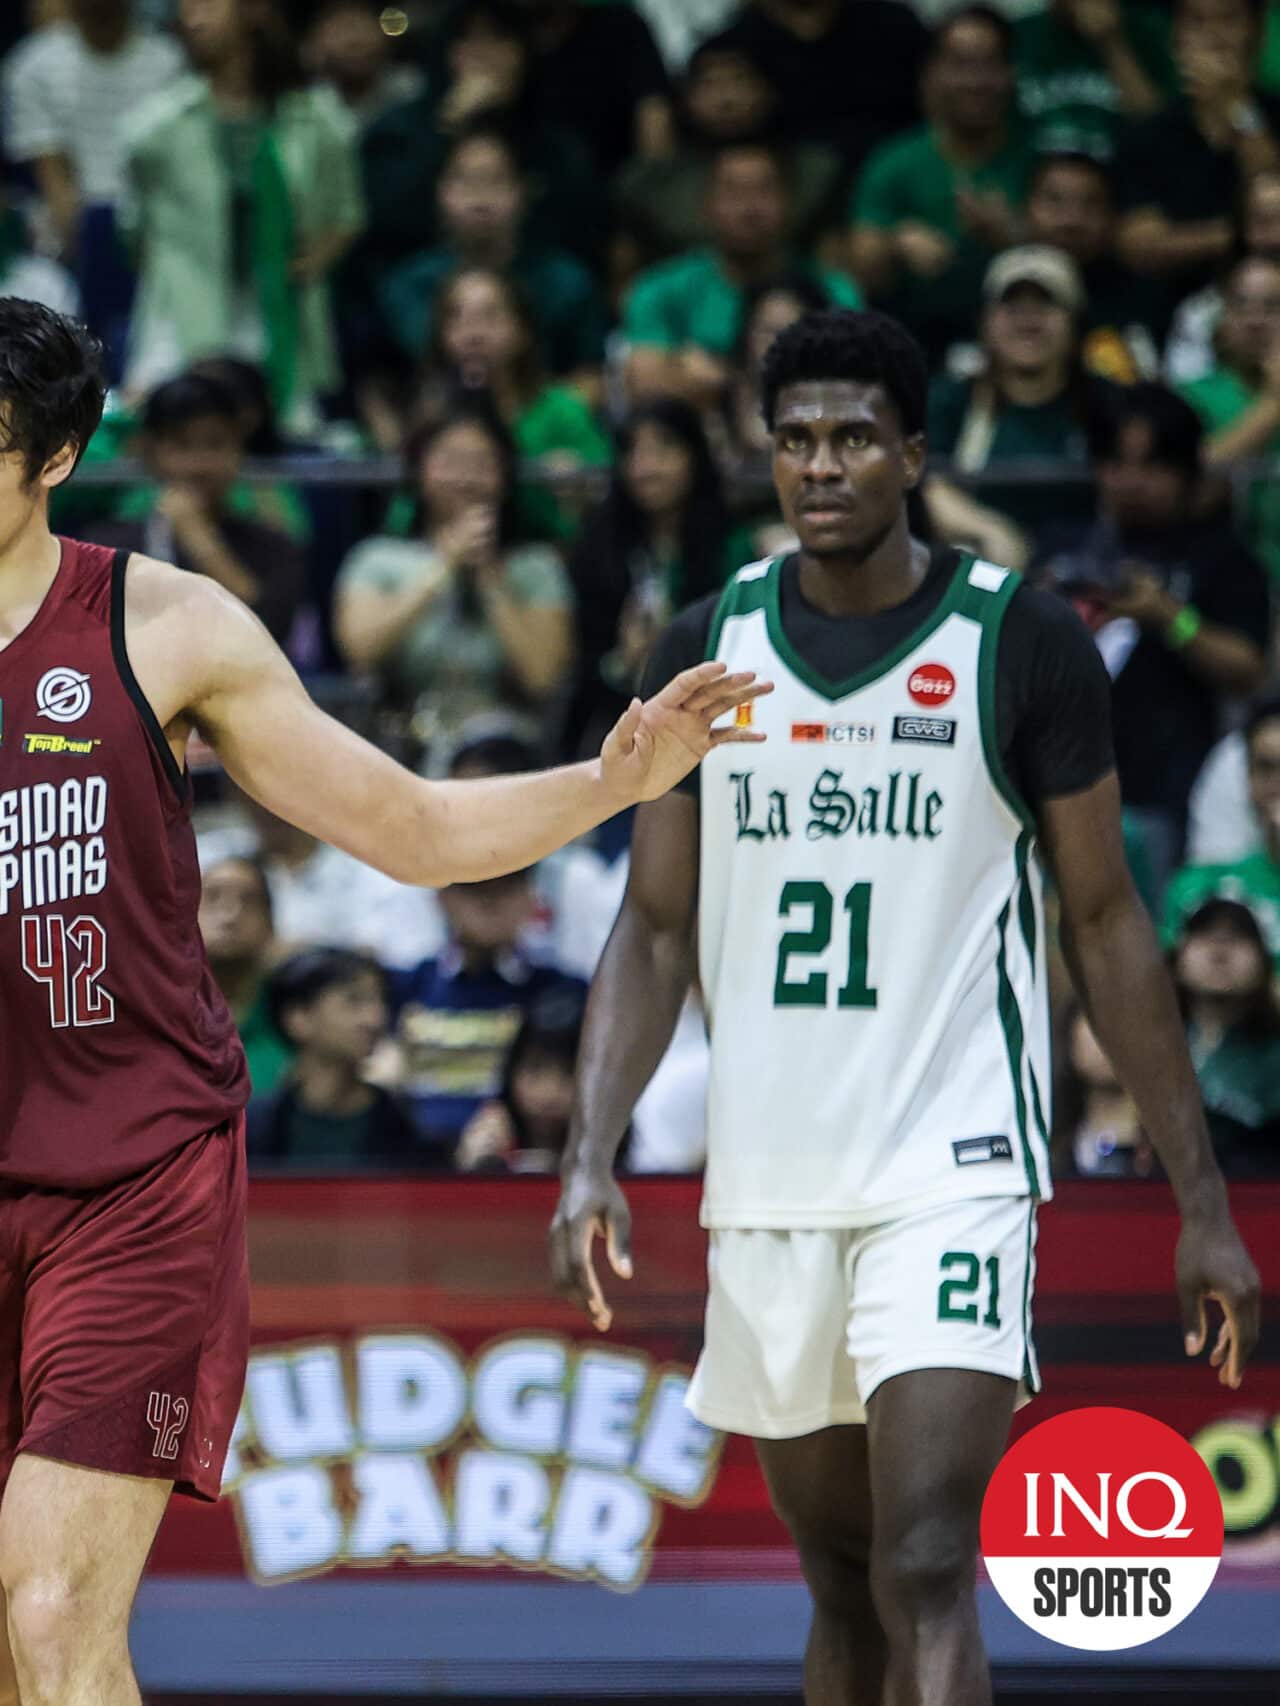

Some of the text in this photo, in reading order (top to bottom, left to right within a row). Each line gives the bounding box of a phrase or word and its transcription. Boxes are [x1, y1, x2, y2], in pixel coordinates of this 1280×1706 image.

[826, 725, 875, 742] ICTSI
[729, 767, 944, 842] La Salle
[20, 914, 115, 1029] 42
[773, 880, 878, 1010] 21
[937, 1251, 1001, 1329] 21
[146, 1392, 188, 1460] 42
[221, 1334, 716, 1500] UDGEE
[238, 1452, 652, 1586] BARR
